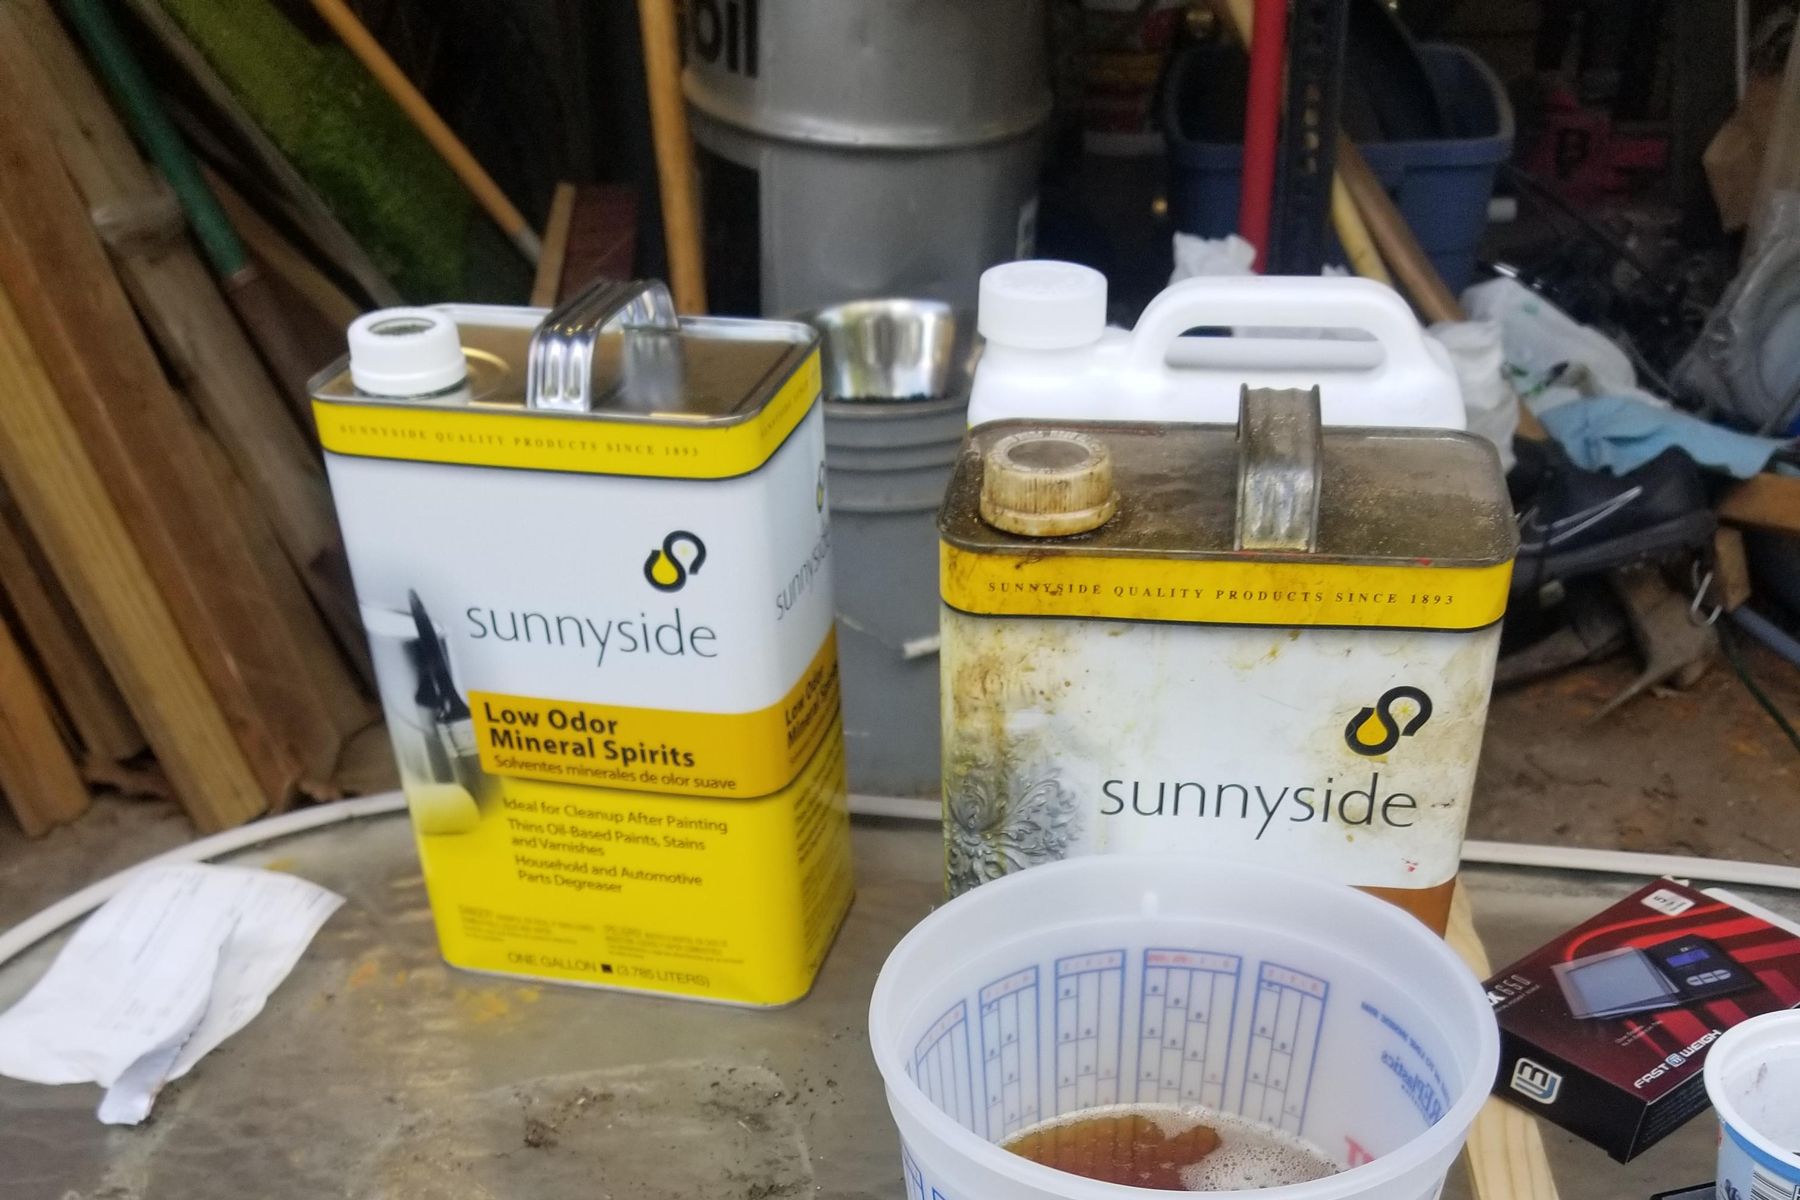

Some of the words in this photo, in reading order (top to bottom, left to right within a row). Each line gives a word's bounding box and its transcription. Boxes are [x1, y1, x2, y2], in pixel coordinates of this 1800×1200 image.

[339, 424, 426, 440] SUNNYSIDE
[435, 431, 504, 446] QUALITY
[513, 437, 597, 451] PRODUCTS
[605, 442, 655, 456] SINCE
[988, 582, 1101, 596] SUNNYSIDE
[1113, 586, 1204, 599] QUALITY
[1216, 589, 1323, 602] PRODUCTS
[1335, 591, 1397, 604] SINCE
[1411, 593, 1454, 605] 1893
[466, 607, 719, 668] sunnyside
[484, 702, 539, 728] Low
[548, 709, 618, 735] Odor
[490, 728, 595, 758] Mineral
[604, 740, 696, 768] Spirits
[493, 755, 563, 775] Solventes
[566, 763, 637, 783] minerales
[639, 770, 658, 784] de
[661, 770, 690, 787] olor
[693, 776, 737, 790] suave
[503, 797, 538, 813] Ideal
[541, 801, 561, 816] for
[564, 804, 624, 824] Cleanup
[628, 812, 663, 827] After
[666, 815, 729, 835] Painting
[1101, 771, 1418, 841] sunnyside
[507, 818, 545, 834] Thins
[546, 823, 612, 842] Oil-Based
[614, 831, 661, 849] Paints,
[663, 835, 706, 851] Stains
[511, 836, 537, 849] and
[539, 838, 605, 857] Varnishes
[515, 854, 589, 874] Household
[592, 863, 617, 878] and
[620, 867, 703, 887] Automotive
[518, 870, 552, 885] Parts
[554, 875, 623, 893] Degreaser
[507, 952, 538, 965] ONE
[540, 955, 597, 973] GALLON
[1633, 1063, 1670, 1089] FAST
[1679, 1029, 1722, 1058] WEIGH
